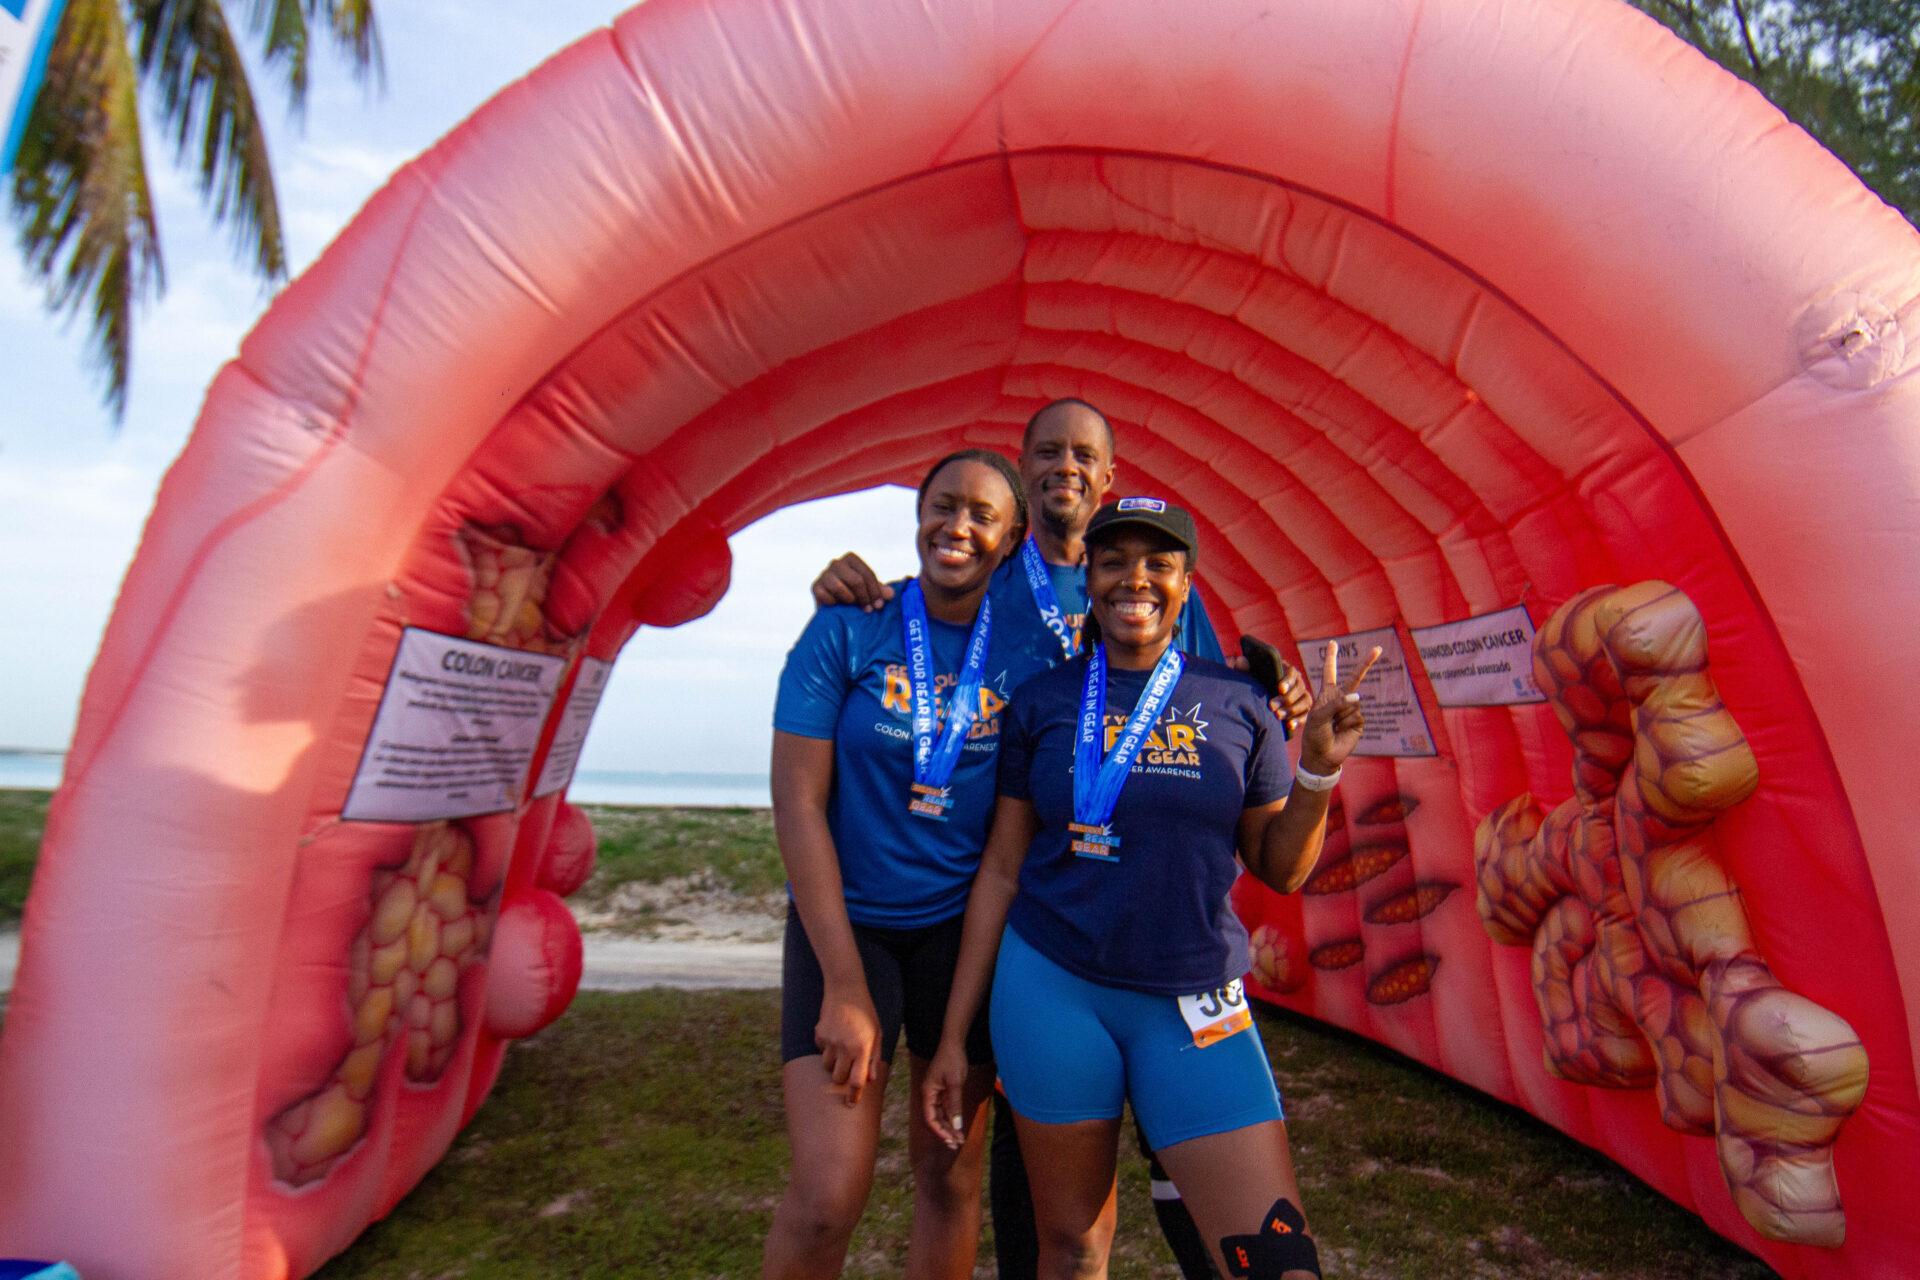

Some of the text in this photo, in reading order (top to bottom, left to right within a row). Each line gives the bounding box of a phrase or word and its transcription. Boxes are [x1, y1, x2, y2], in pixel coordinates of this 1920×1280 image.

[909, 619, 922, 642] GET
[979, 622, 988, 638] IN
[1452, 639, 1483, 656] COLON
[1482, 628, 1527, 651] CANCER
[912, 644, 926, 680] YOUR
[969, 637, 984, 669] GEAR
[441, 650, 543, 683] COLON CANCER
[1087, 671, 1099, 698] REAR
[1151, 665, 1174, 697] YOUR
[915, 681, 931, 715] REAR
[1086, 699, 1097, 711] IN
[1138, 694, 1160, 723] REAR
[875, 723, 910, 741] COLON
[918, 717, 931, 734] IN
[1082, 712, 1096, 743] GEAR
[1131, 722, 1146, 736] IN
[1113, 735, 1138, 764] GEAR
[1147, 751, 1201, 767] GEAR
[1145, 767, 1202, 780] AWARENESS
[1074, 841, 1108, 856] GEAR
[1085, 833, 1111, 846] REAR
